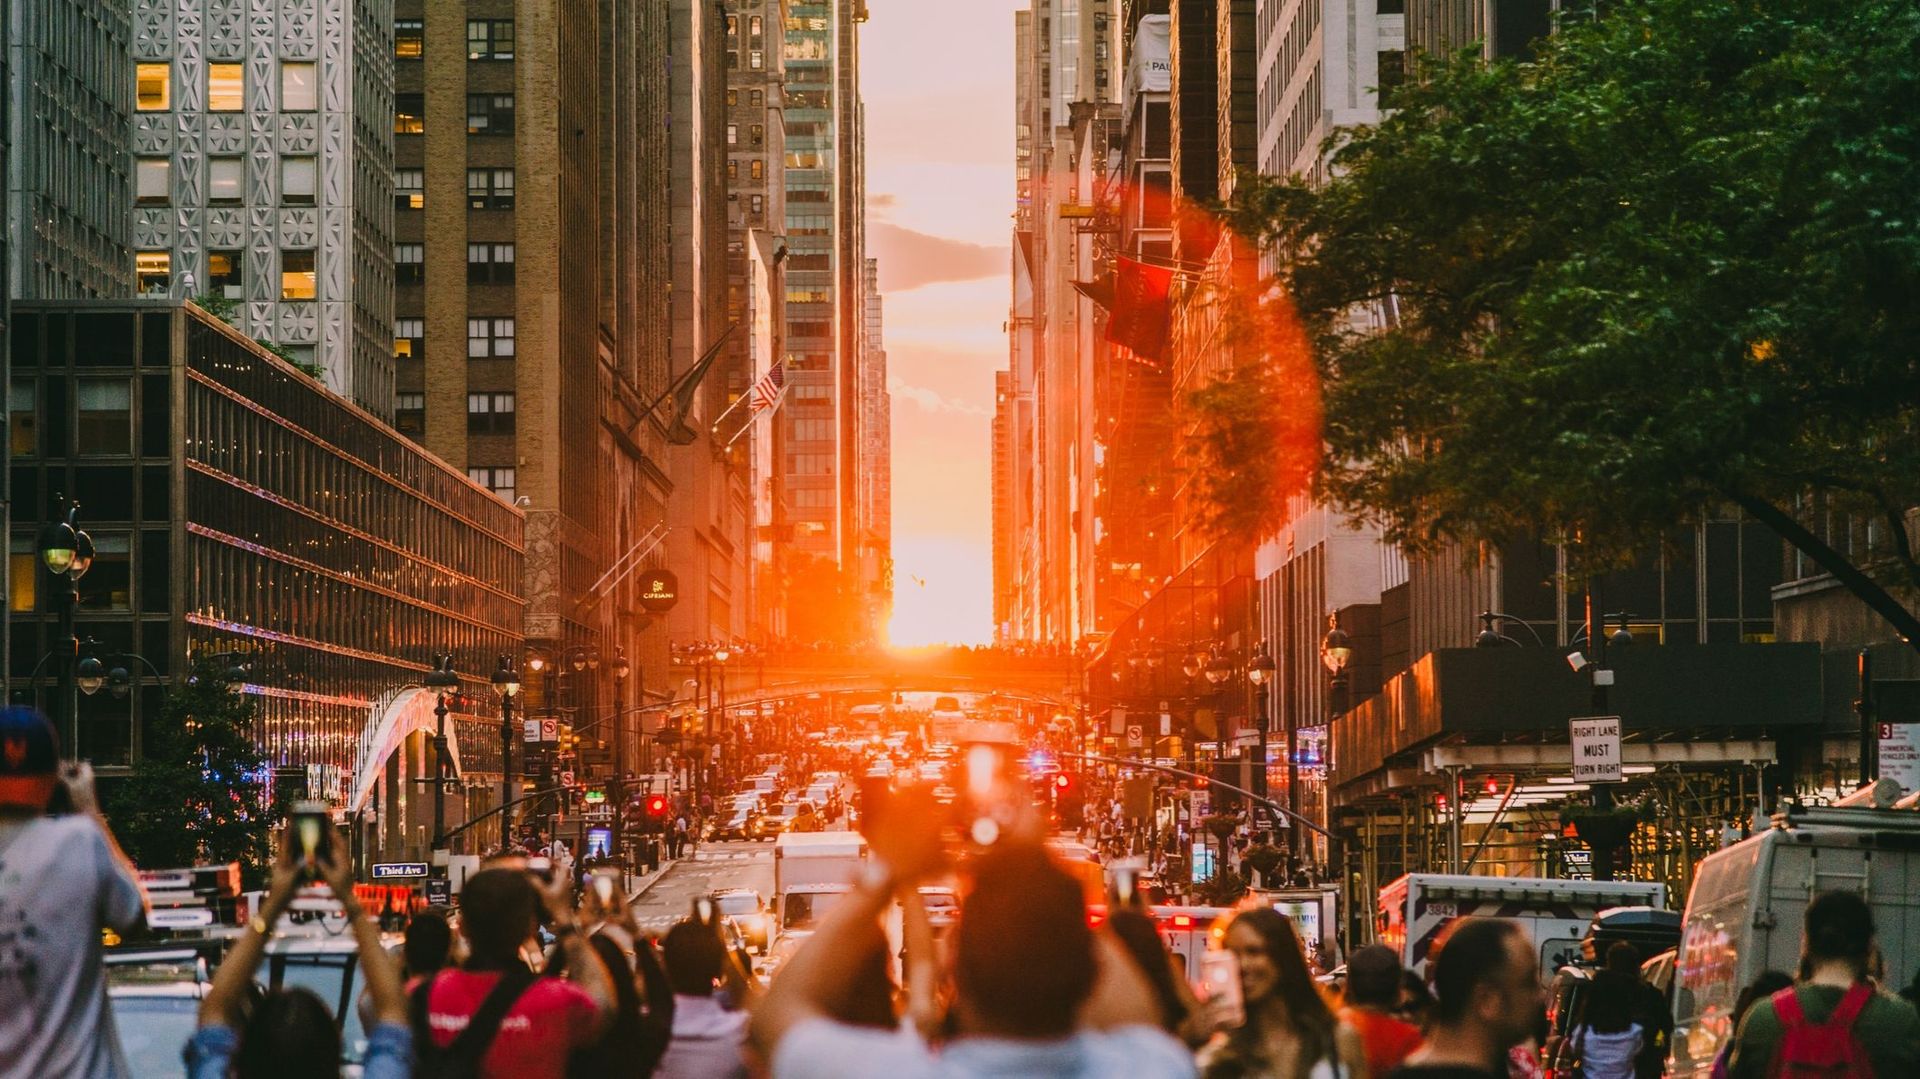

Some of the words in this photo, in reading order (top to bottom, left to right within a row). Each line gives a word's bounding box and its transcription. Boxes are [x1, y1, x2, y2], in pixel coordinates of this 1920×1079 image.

[1574, 727, 1596, 737] RIGHT
[1598, 726, 1617, 736] LANE
[1882, 724, 1890, 738] 3
[1584, 744, 1609, 757] MUST
[1880, 744, 1915, 752] COMMERCIAL
[1575, 764, 1595, 775] TURN
[1598, 763, 1619, 774] RIGHT
[1564, 854, 1589, 862] Third
[380, 867, 403, 876] Third
[405, 866, 421, 875] Ave
